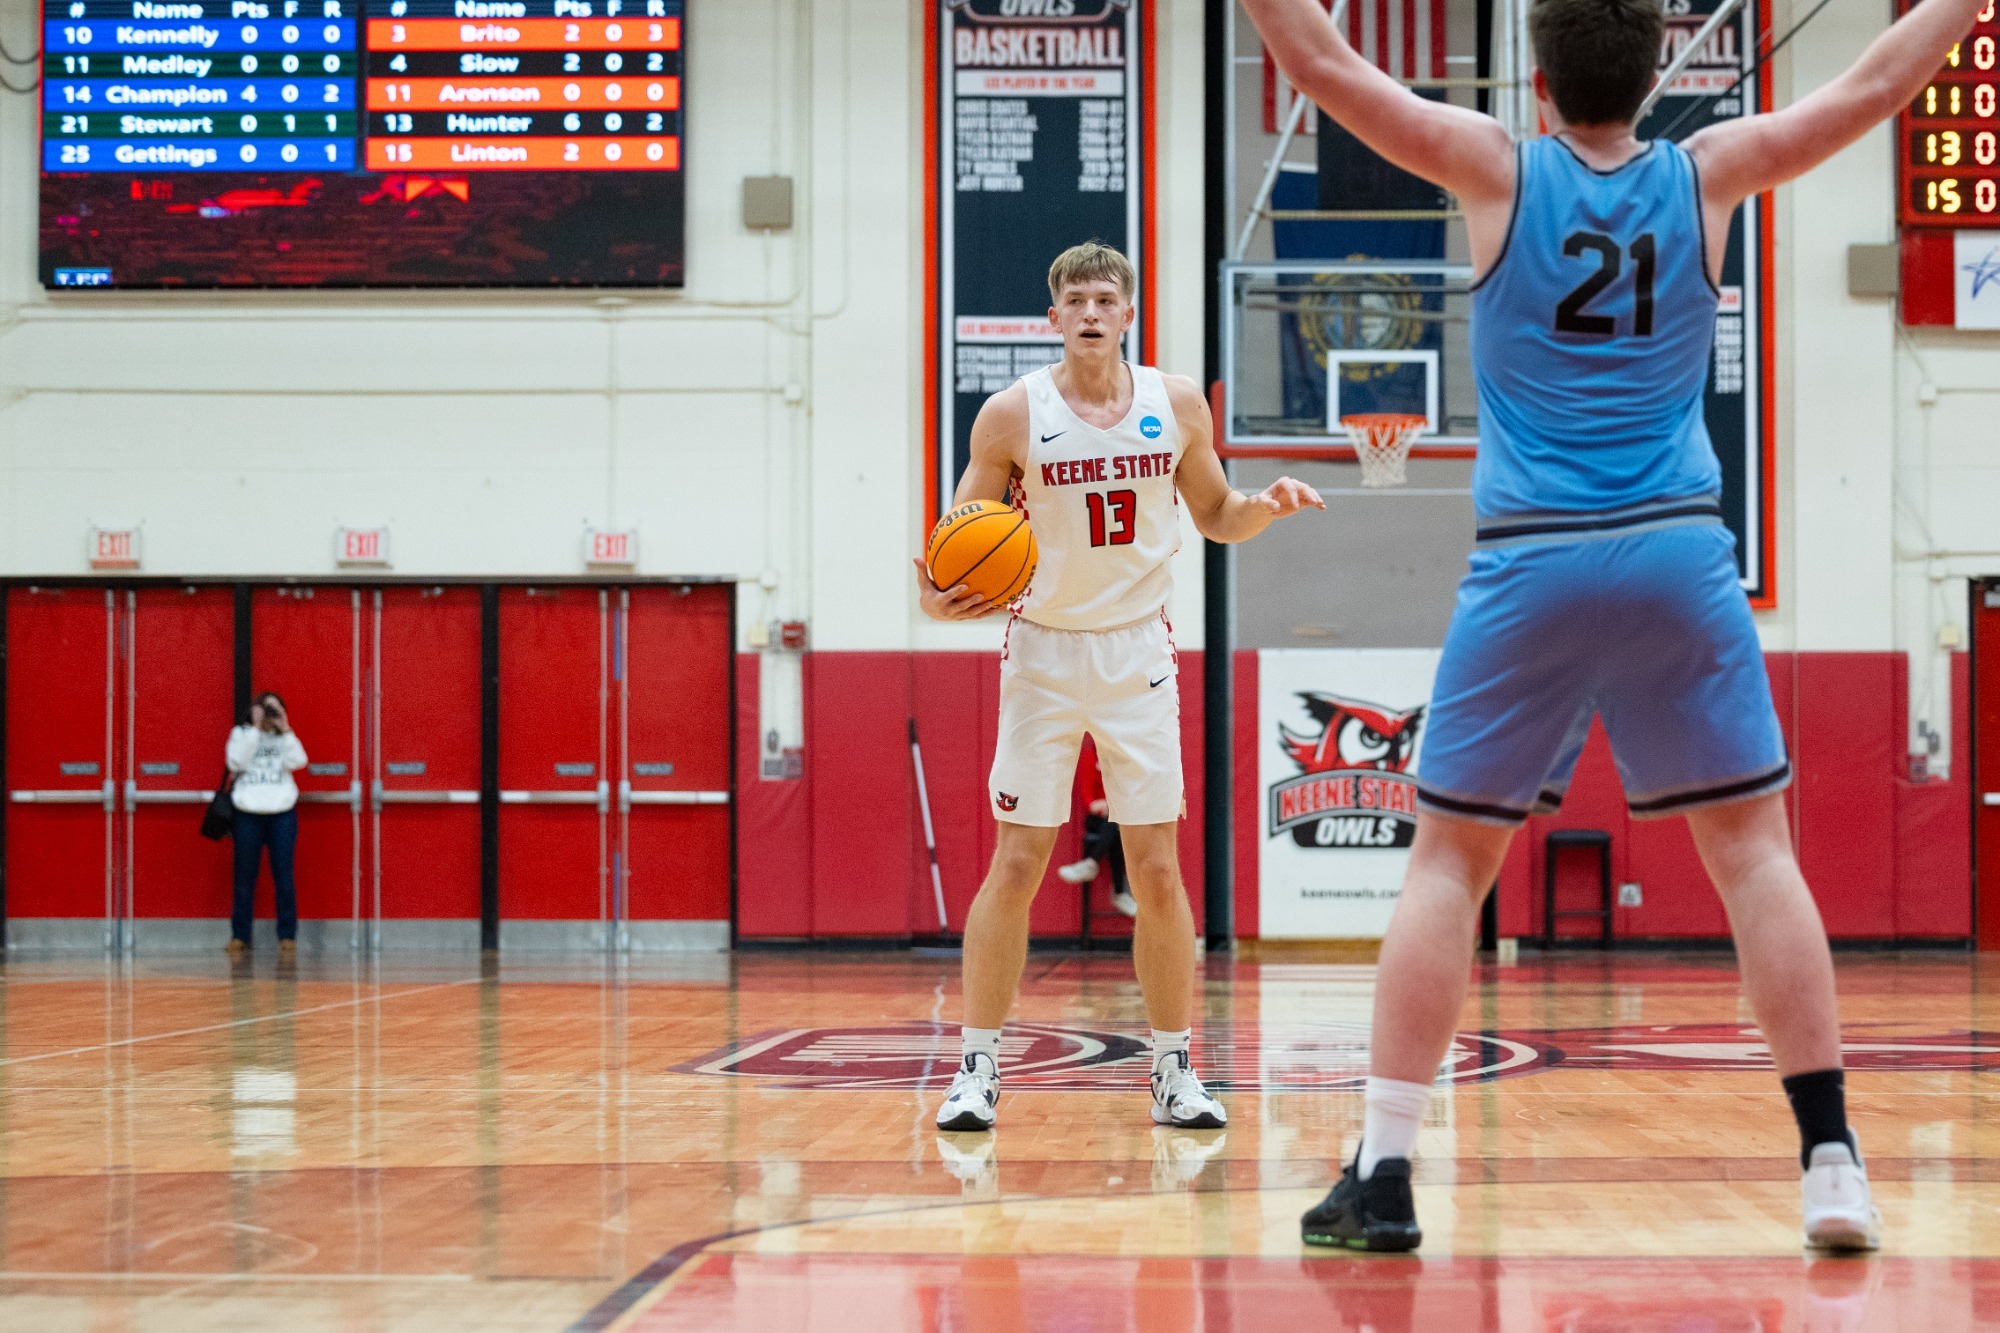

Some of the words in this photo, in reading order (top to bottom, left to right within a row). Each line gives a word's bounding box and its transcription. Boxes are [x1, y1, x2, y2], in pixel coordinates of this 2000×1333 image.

[133, 2, 203, 18] Name
[232, 1, 269, 18] Pts
[284, 1, 298, 18] F
[324, 1, 341, 18] R
[455, 0, 526, 17] Name
[554, 0, 592, 17] Pts
[607, 0, 621, 16] F
[647, 0, 665, 16] R
[65, 26, 92, 44] 10
[117, 25, 219, 48] Kennelly
[241, 25, 258, 43] 0
[282, 25, 299, 43] 0
[323, 25, 341, 43] 0
[391, 25, 406, 42] 3
[460, 25, 521, 42] Brito
[565, 25, 580, 42] 2
[605, 24, 622, 42] 0
[648, 24, 663, 42] 3
[955, 28, 1124, 66] BASKETBALL
[65, 56, 89, 73] 11
[123, 55, 212, 77] Medley
[241, 55, 258, 73] 0
[282, 55, 299, 73] 0
[323, 55, 340, 73] 0
[389, 54, 408, 72] 4
[563, 53, 581, 71] 2
[604, 53, 623, 71] 0
[646, 53, 664, 71] 2
[1974, 36, 1995, 70] 0
[64, 86, 92, 103] 14
[105, 85, 228, 107] Champion
[241, 85, 257, 102] 4
[281, 85, 299, 102] 0
[324, 84, 340, 102] 2
[385, 84, 411, 102] 11
[439, 84, 540, 102] Aronson
[563, 83, 580, 101] 0
[605, 83, 622, 101] 0
[647, 83, 664, 101] 0
[1926, 86, 1960, 115] 11
[1974, 83, 1996, 118] 0
[61, 115, 88, 133] 21
[121, 115, 213, 133] Stewart
[240, 115, 257, 132] 0
[284, 115, 296, 132] 1
[326, 115, 337, 132] 1
[384, 114, 413, 132] 13
[446, 114, 533, 132] Hunter
[563, 113, 581, 131] 6
[604, 113, 623, 131] 0
[646, 113, 664, 131] 2
[61, 145, 90, 163] 25
[115, 145, 217, 168] Gettings
[240, 144, 257, 162] 0
[281, 144, 299, 162] 0
[326, 144, 337, 162] 1
[385, 144, 412, 162] 15
[451, 144, 528, 162] Linton
[563, 143, 580, 161] 2
[604, 143, 622, 161] 0
[646, 143, 664, 161] 0
[1926, 130, 1961, 166] 13
[1975, 131, 1996, 165] 0
[1926, 178, 1961, 213] 15
[1975, 179, 1996, 213] 0
[1555, 230, 1656, 336] 21
[1041, 457, 1108, 487] KEENE
[1113, 452, 1172, 480] STATE
[1085, 489, 1137, 548] 13
[97, 530, 131, 558] EXIT
[345, 529, 379, 558] EXIT
[593, 531, 627, 560] EXIT
[1279, 777, 1356, 821] KEENE
[1358, 776, 1417, 816] STAT
[1315, 817, 1397, 846] OWLS
